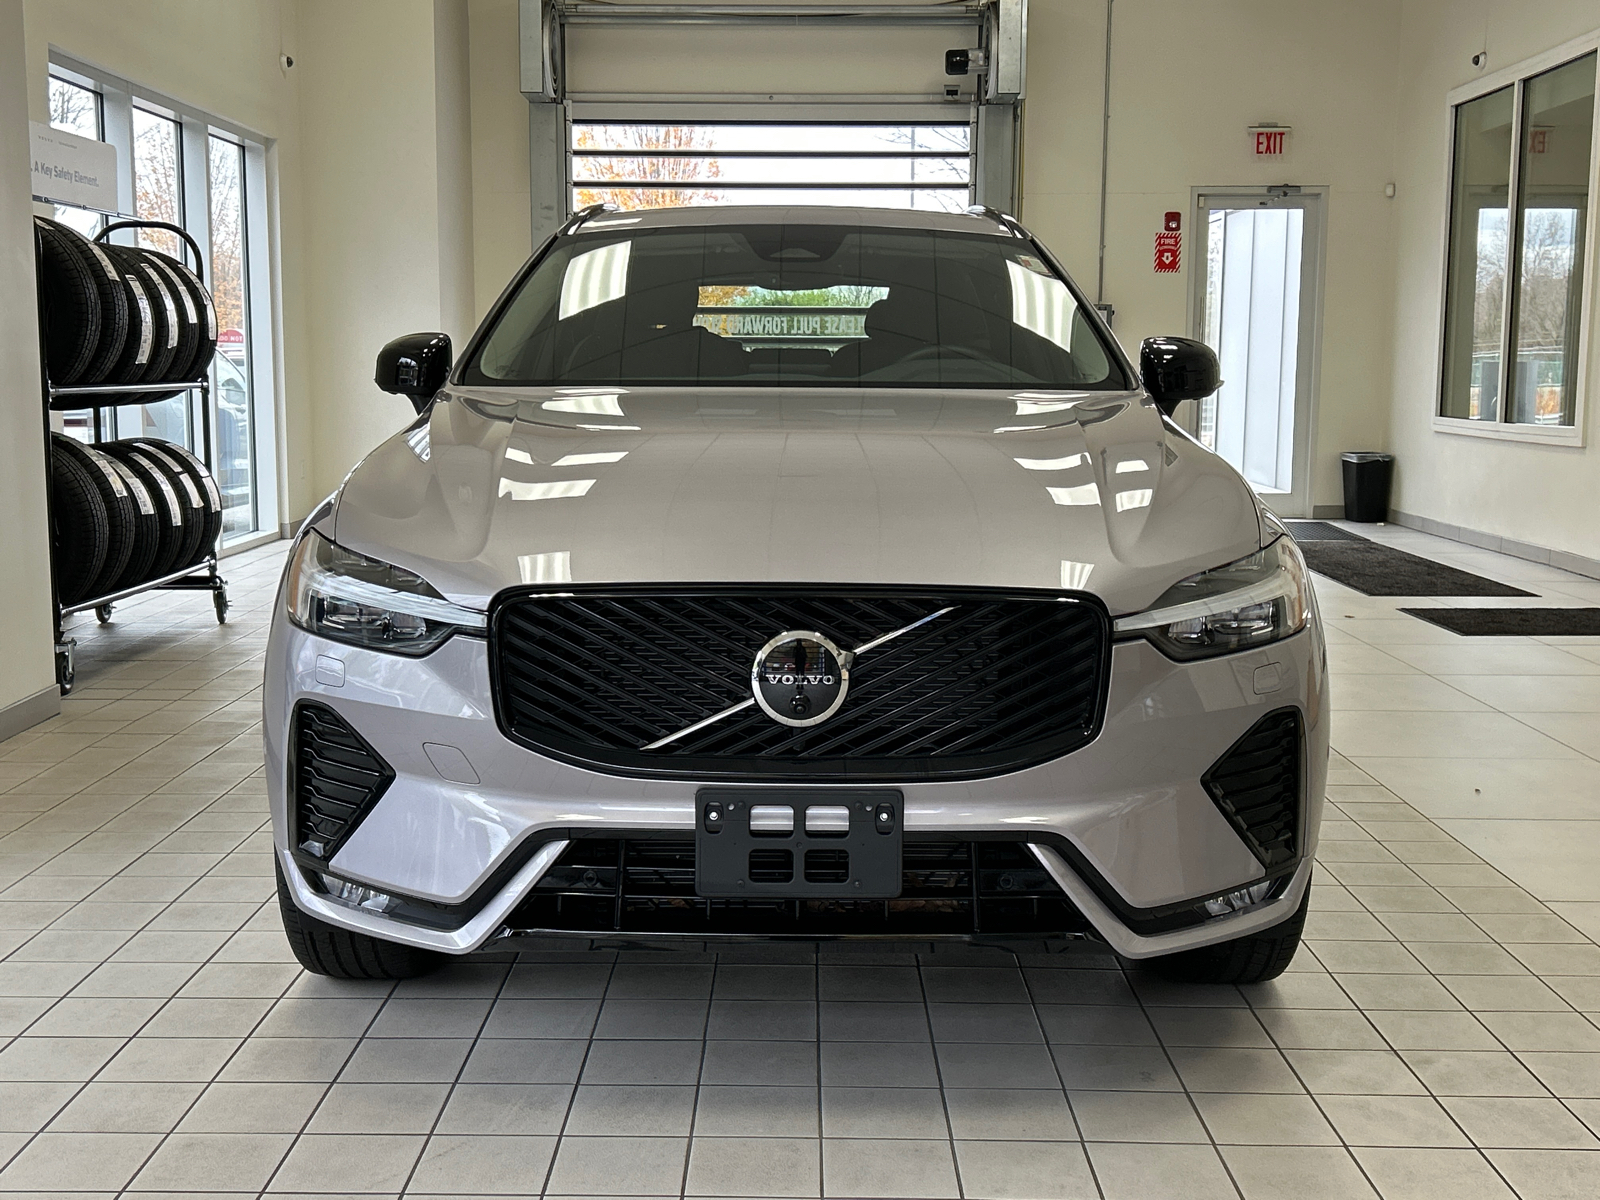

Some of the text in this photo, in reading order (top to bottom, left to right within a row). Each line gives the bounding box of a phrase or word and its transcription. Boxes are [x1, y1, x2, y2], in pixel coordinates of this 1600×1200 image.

[1256, 132, 1285, 154] EXIT
[35, 160, 99, 187] A Key Safety Element.
[765, 674, 835, 685] VOLVO
